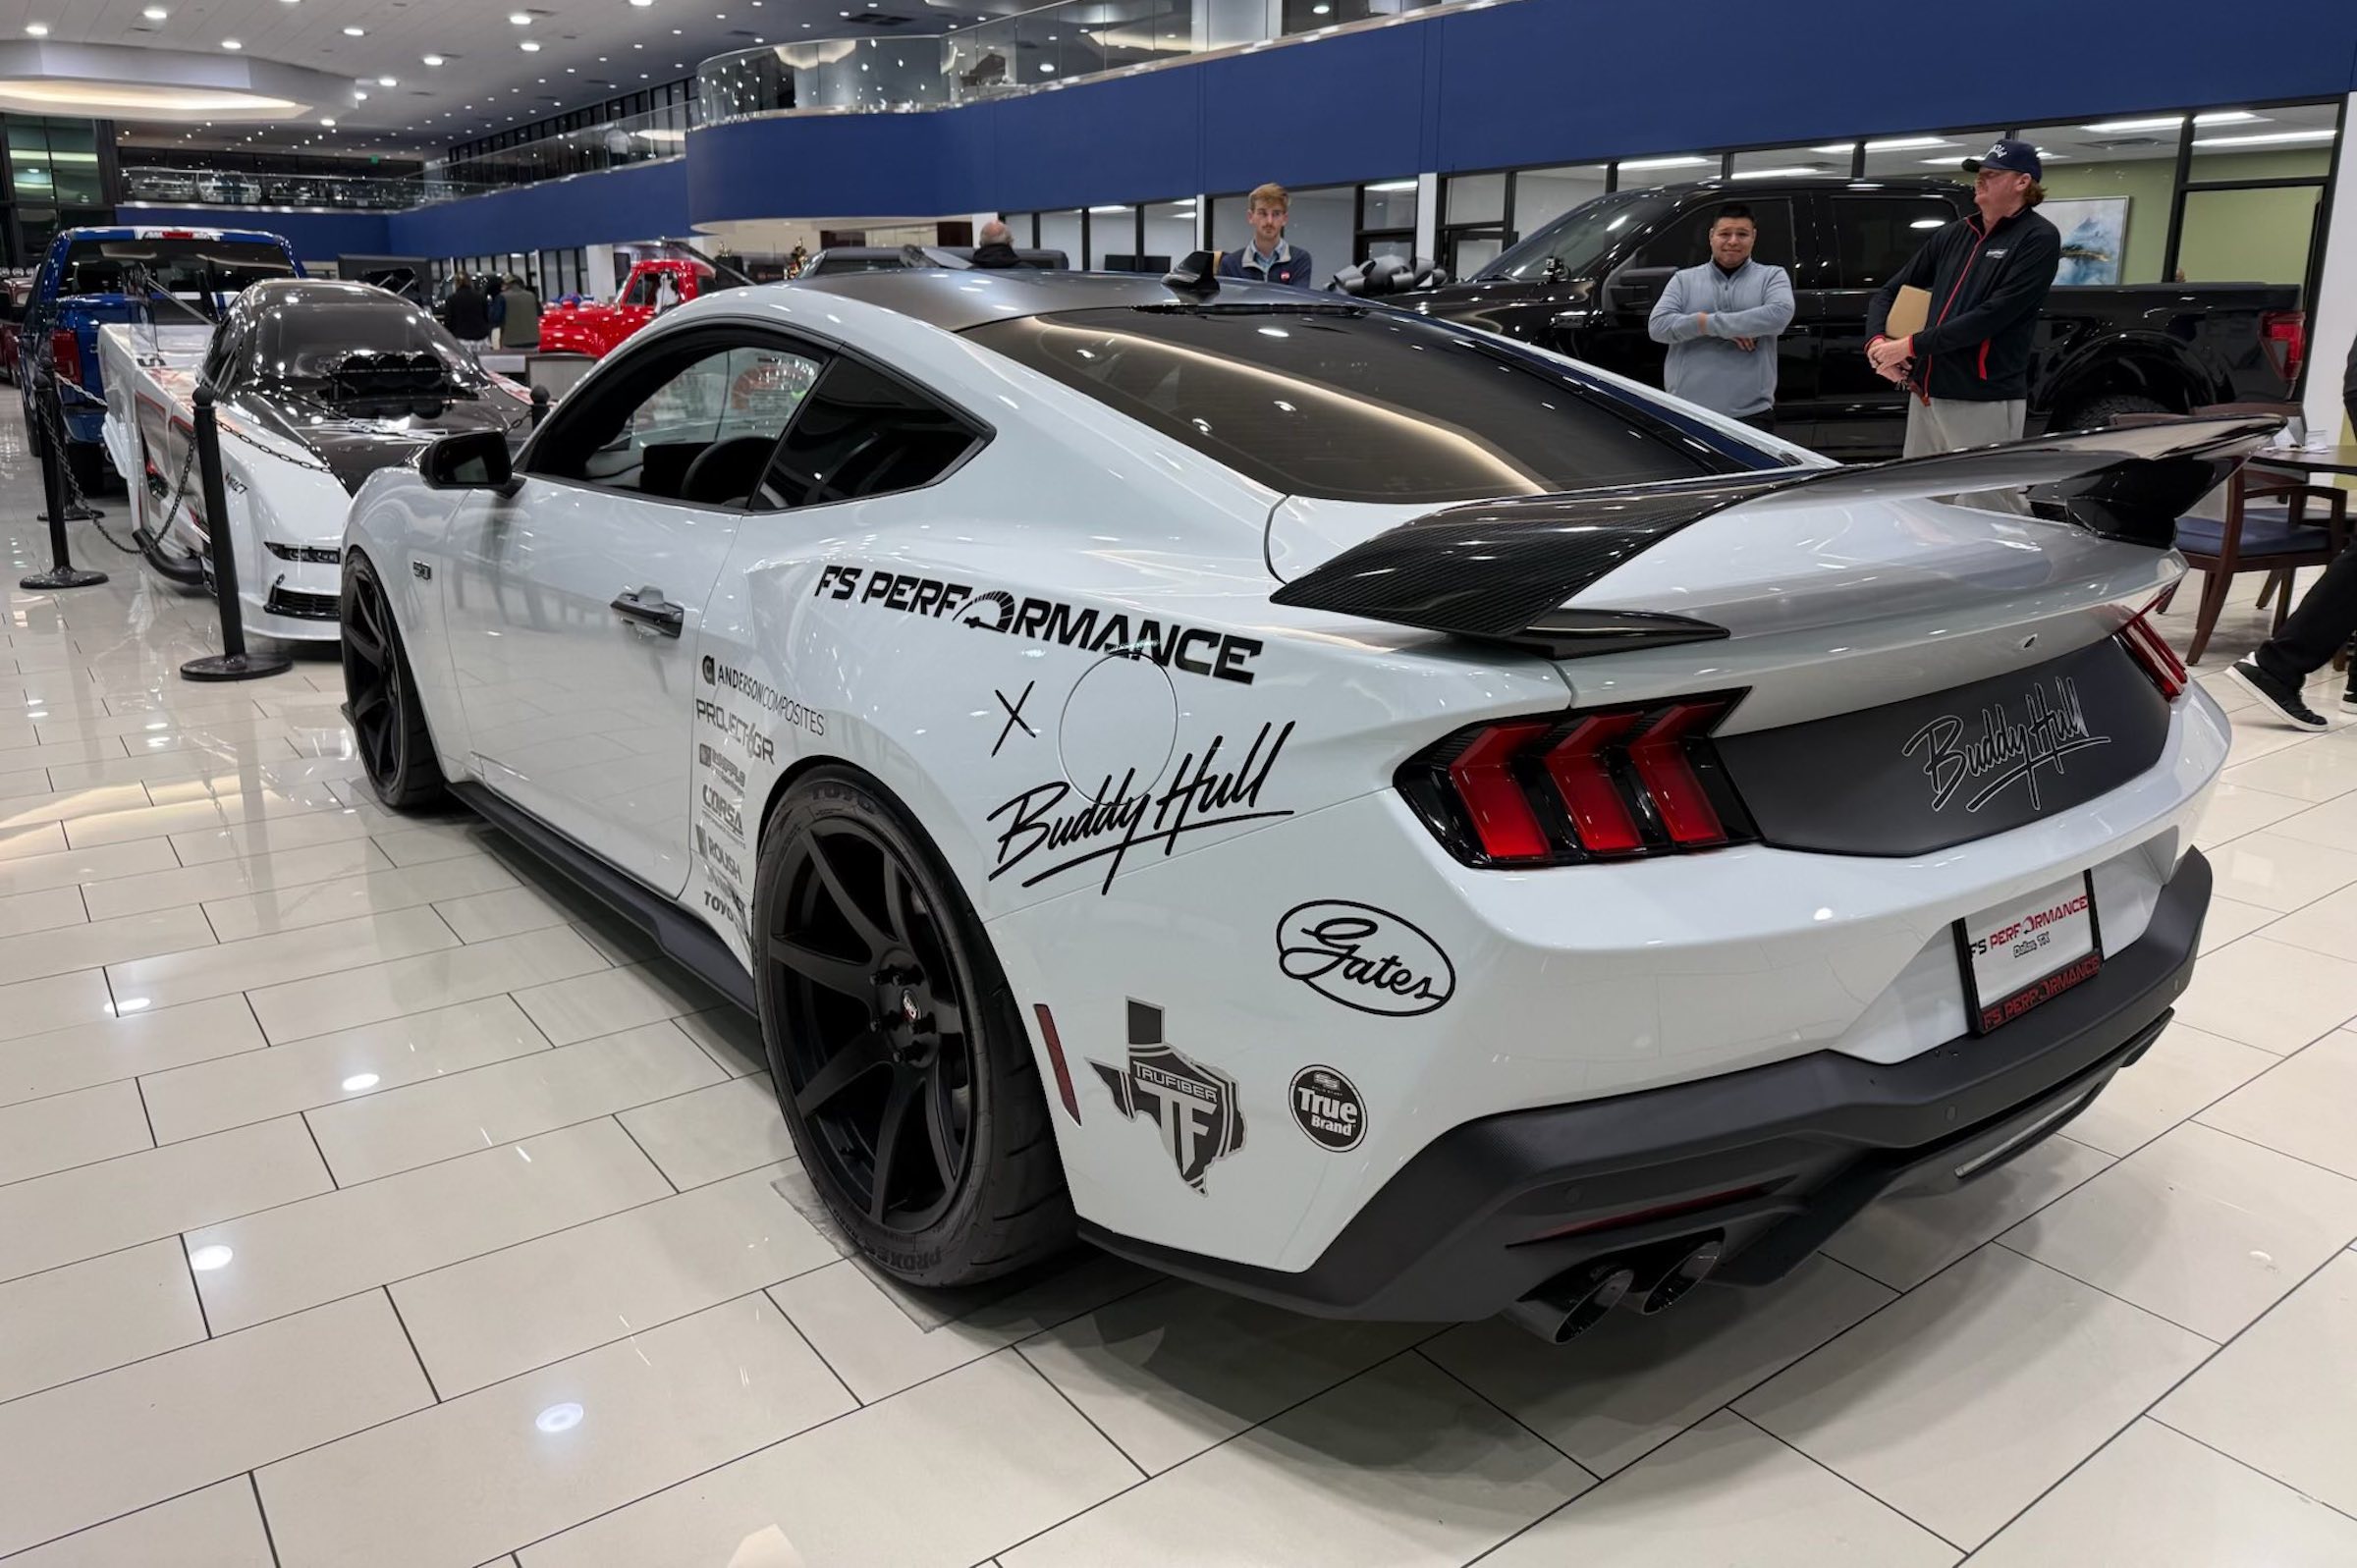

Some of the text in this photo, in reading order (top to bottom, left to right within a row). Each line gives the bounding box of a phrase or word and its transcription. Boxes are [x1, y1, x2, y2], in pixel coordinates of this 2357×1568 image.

[814, 565, 1264, 685] FS PERFORMANCE
[1902, 676, 2090, 812] Buddy Hull
[987, 721, 1295, 895] Buddy Hull
[1280, 917, 1434, 999] Gates
[1970, 895, 2089, 958] FS PERFORMANCE
[1983, 955, 2100, 1030] FS PERFORMANCE
[1133, 1060, 1218, 1102] TRUFIBER
[1298, 1087, 1357, 1123] True
[1135, 1077, 1218, 1176] TF
[1311, 1114, 1352, 1136] Brand
